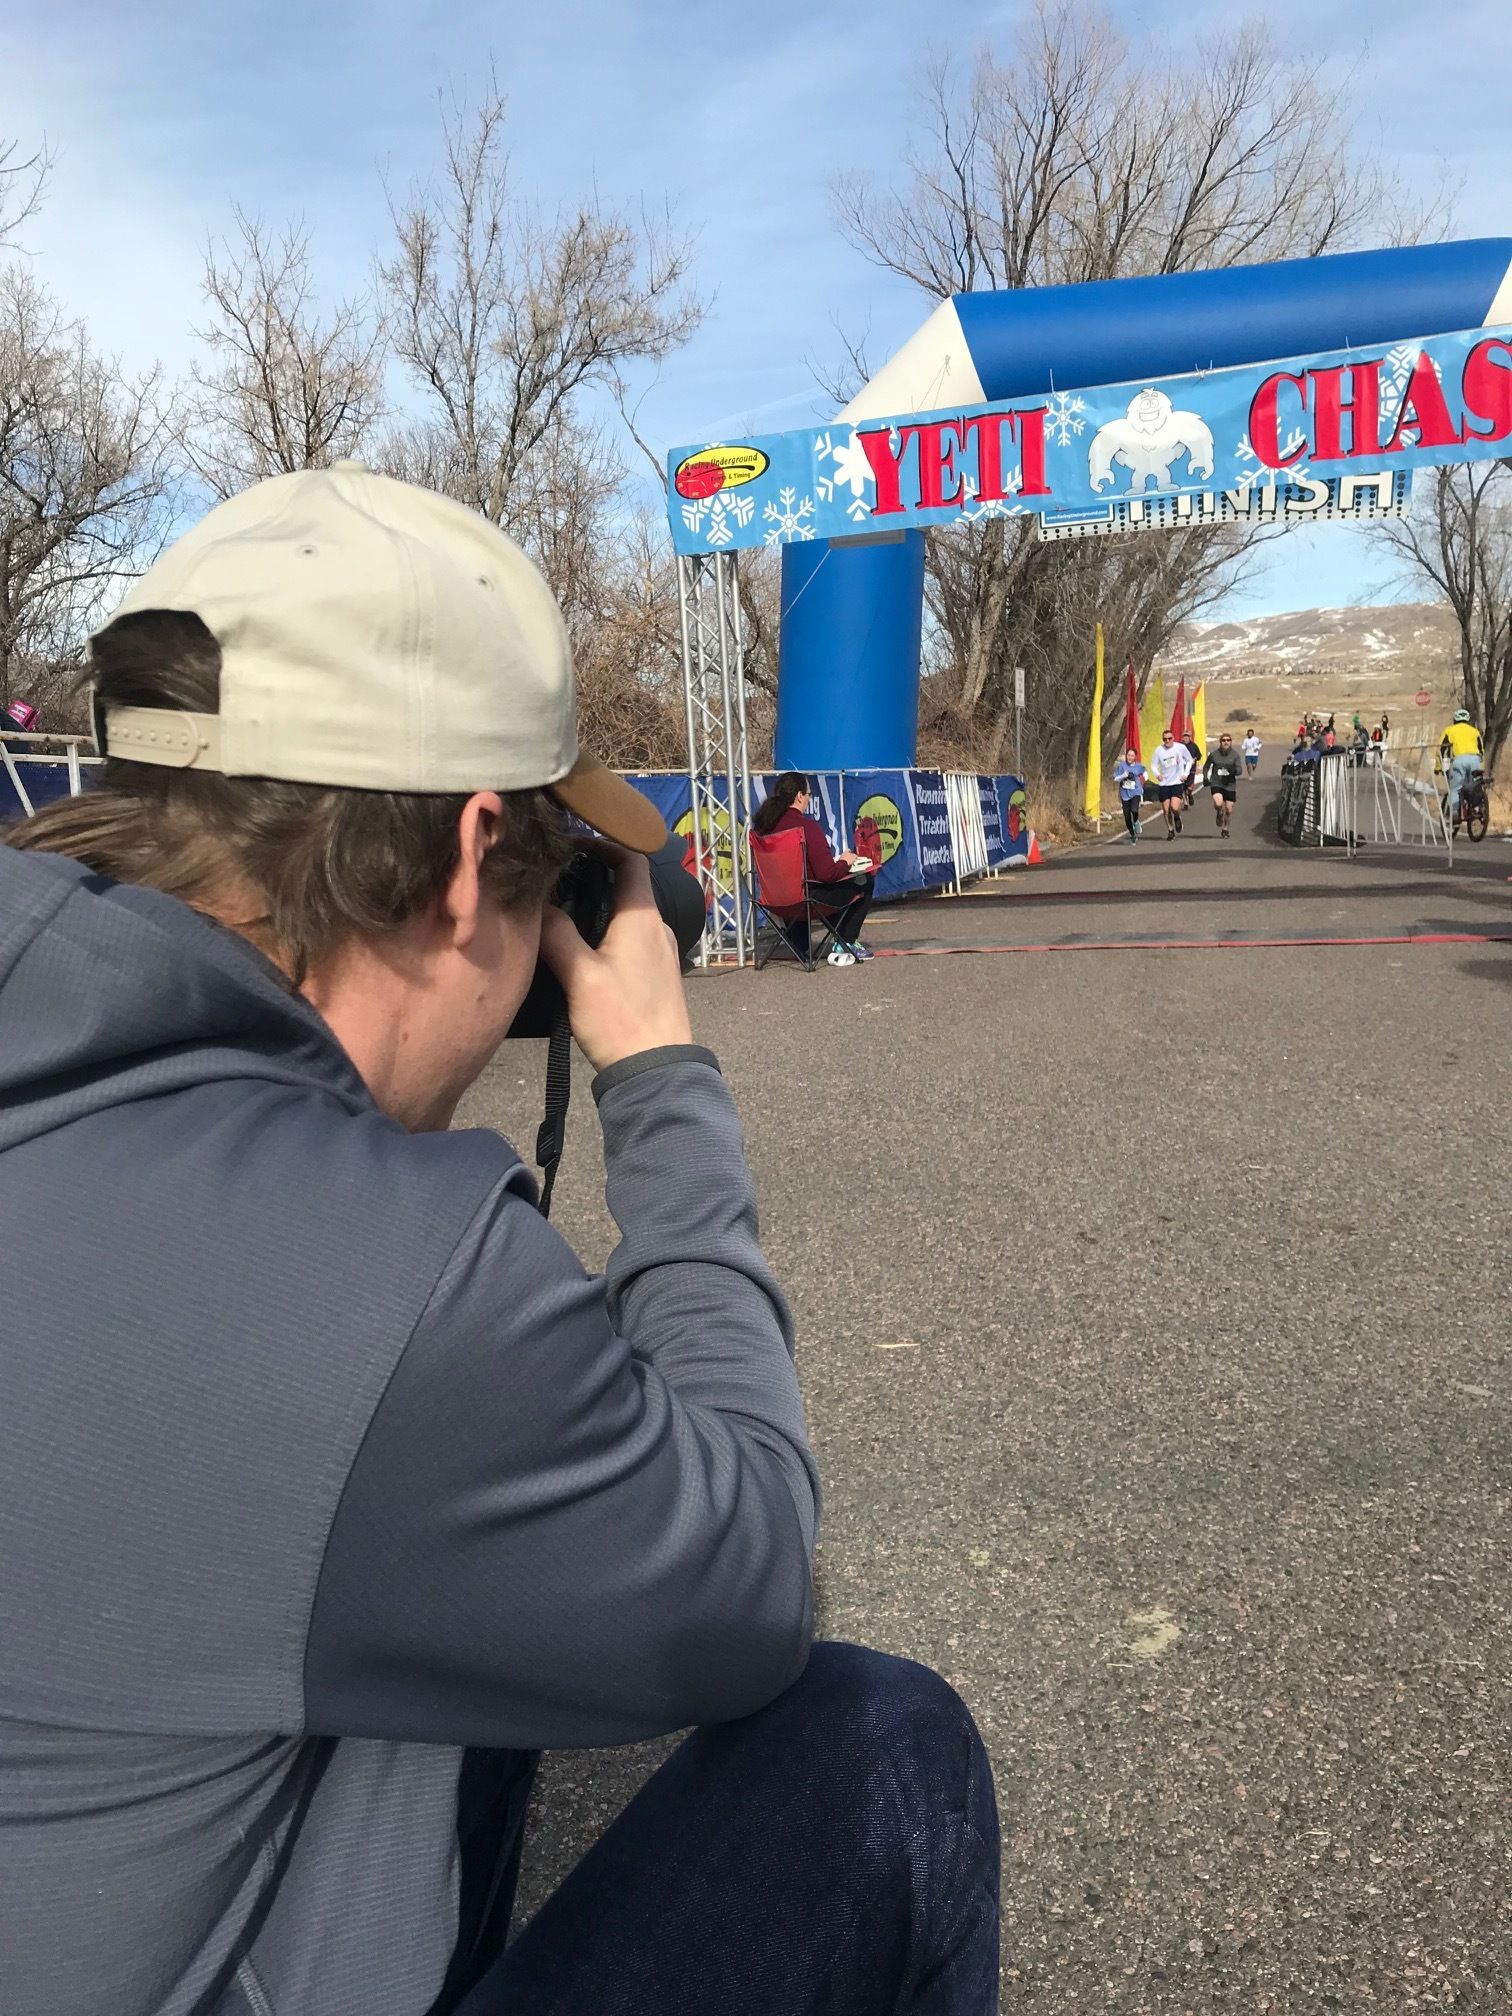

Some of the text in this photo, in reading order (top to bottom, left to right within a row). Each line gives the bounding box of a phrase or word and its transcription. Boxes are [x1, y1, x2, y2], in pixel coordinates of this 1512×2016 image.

[684, 452, 758, 471] Racing Underground
[856, 406, 1052, 516] YETI
[916, 783, 948, 805] Runnin
[919, 814, 950, 835] Triathl
[922, 844, 954, 866] Duathl
